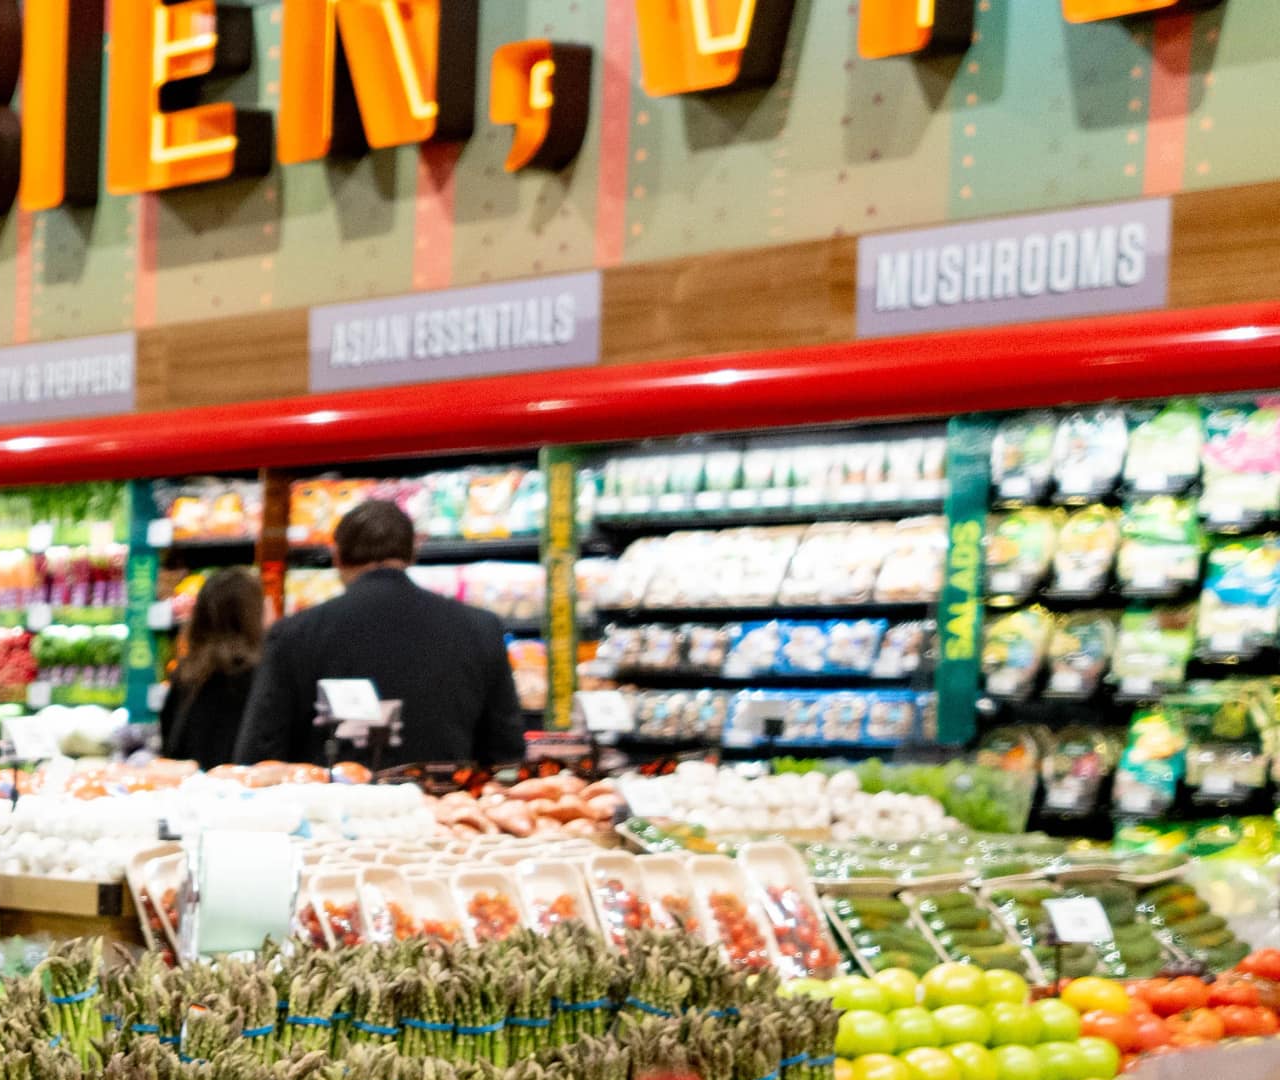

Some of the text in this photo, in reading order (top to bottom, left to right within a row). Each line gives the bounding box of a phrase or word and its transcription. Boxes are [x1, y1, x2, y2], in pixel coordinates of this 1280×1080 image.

[876, 221, 1147, 311] MUSHROOMS
[329, 291, 576, 368] ASIAN ESSENTIALS
[945, 519, 982, 661] SALADS
